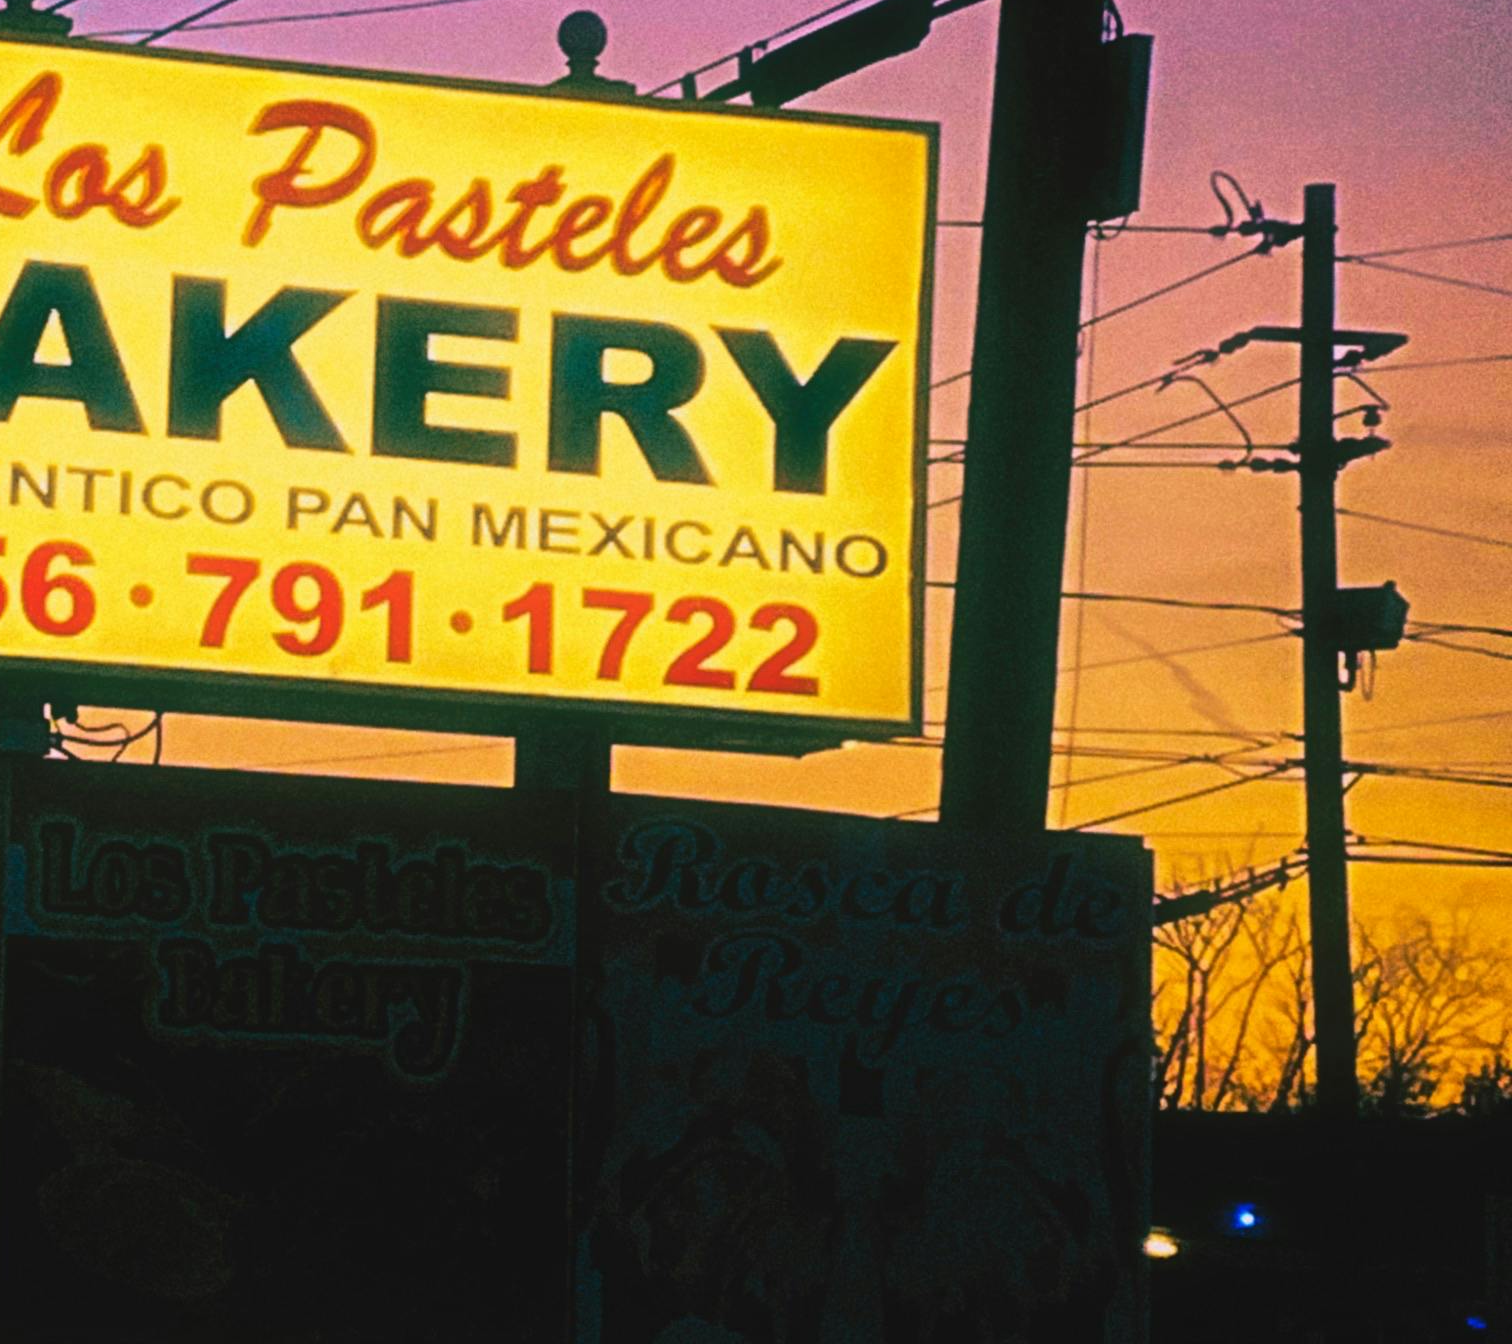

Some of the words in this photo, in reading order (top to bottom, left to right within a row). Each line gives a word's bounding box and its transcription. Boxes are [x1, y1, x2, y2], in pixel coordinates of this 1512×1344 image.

[244, 98, 783, 290] Pasteles
[287, 488, 439, 541] PAN
[473, 506, 889, 579] MEXICANO
[38, 819, 189, 924] Los
[207, 830, 551, 941] Pasteles
[996, 850, 1125, 939] de
[159, 941, 463, 1075] Bakery
[691, 932, 1025, 1059] Reyes
